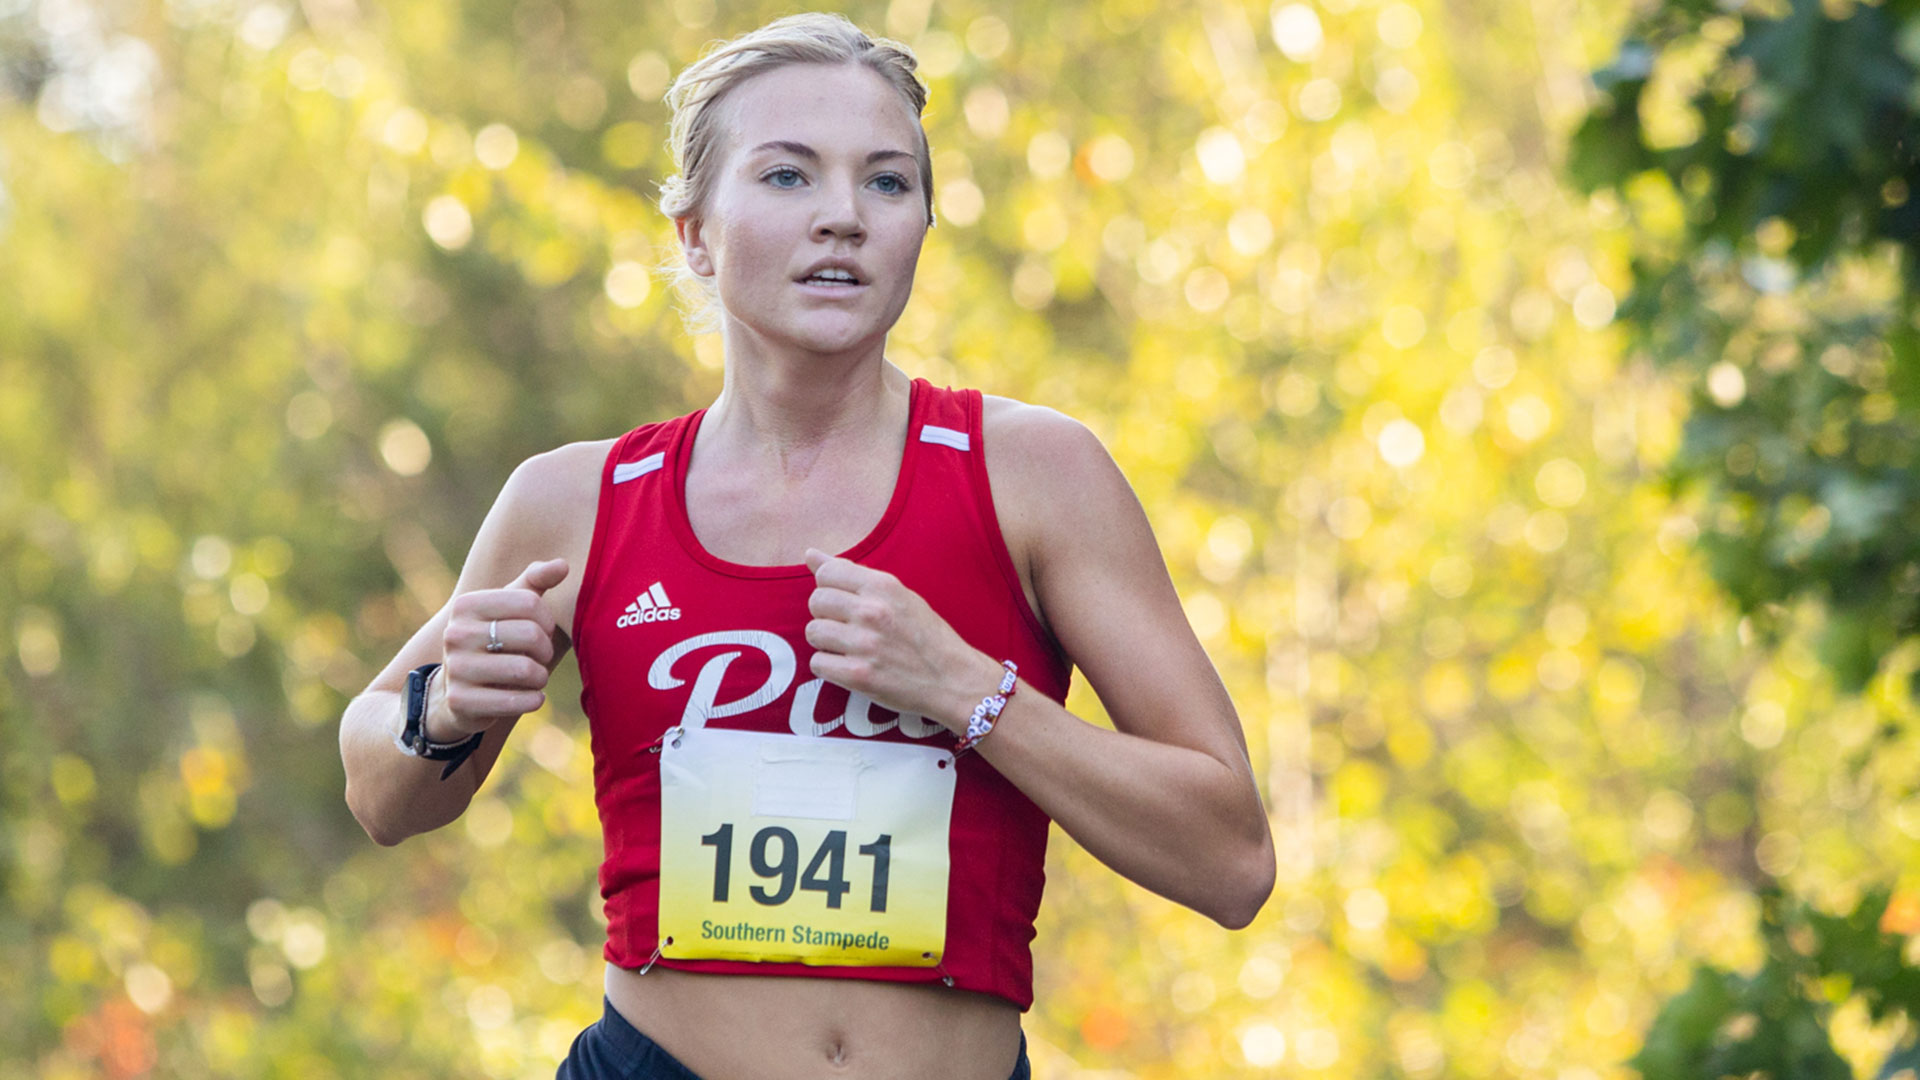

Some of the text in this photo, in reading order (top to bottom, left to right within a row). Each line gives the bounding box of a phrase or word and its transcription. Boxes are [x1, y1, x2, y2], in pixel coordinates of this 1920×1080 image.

[616, 606, 681, 628] adidas
[701, 823, 892, 913] 1941
[701, 919, 890, 951] Southern Stampede
